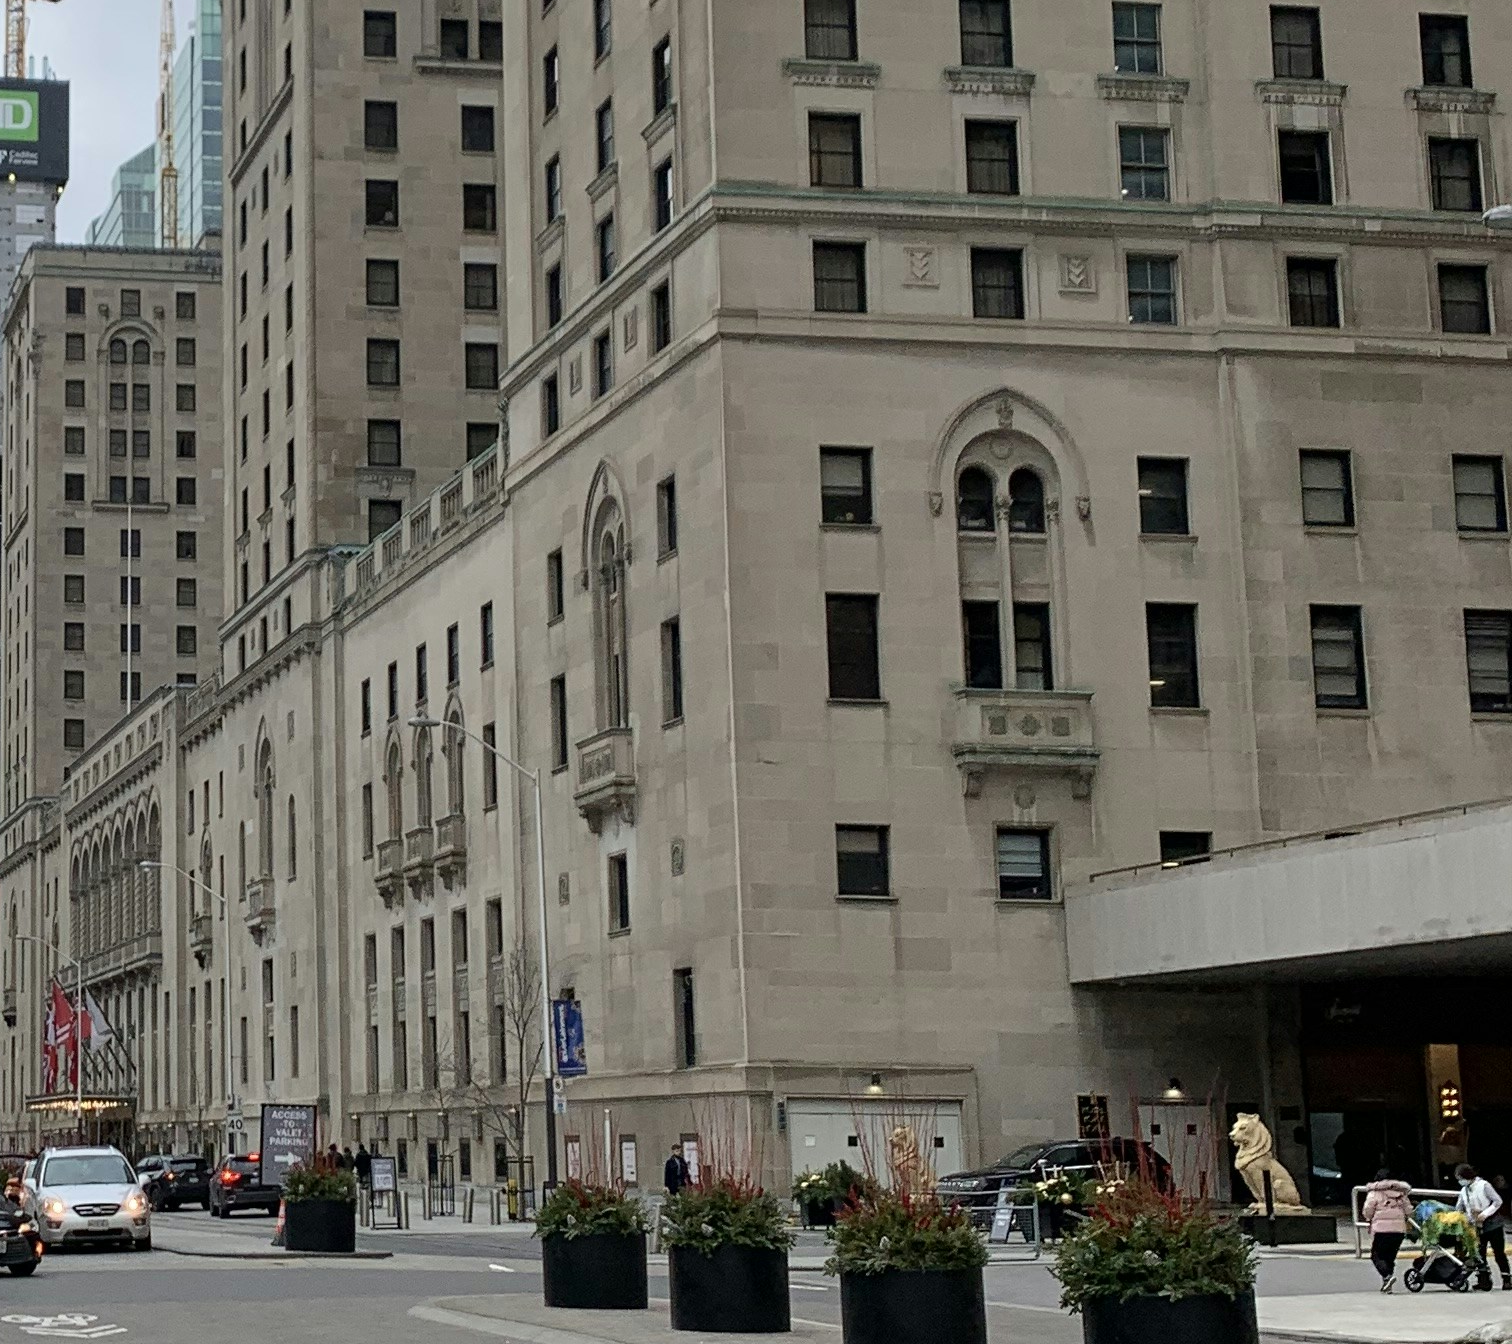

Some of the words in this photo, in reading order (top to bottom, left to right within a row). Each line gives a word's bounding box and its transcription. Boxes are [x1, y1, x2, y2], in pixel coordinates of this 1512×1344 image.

[271, 1110, 308, 1120] ACCESS
[228, 1119, 243, 1130] 40
[275, 1128, 302, 1137] VALET
[269, 1137, 308, 1145] PARKING
